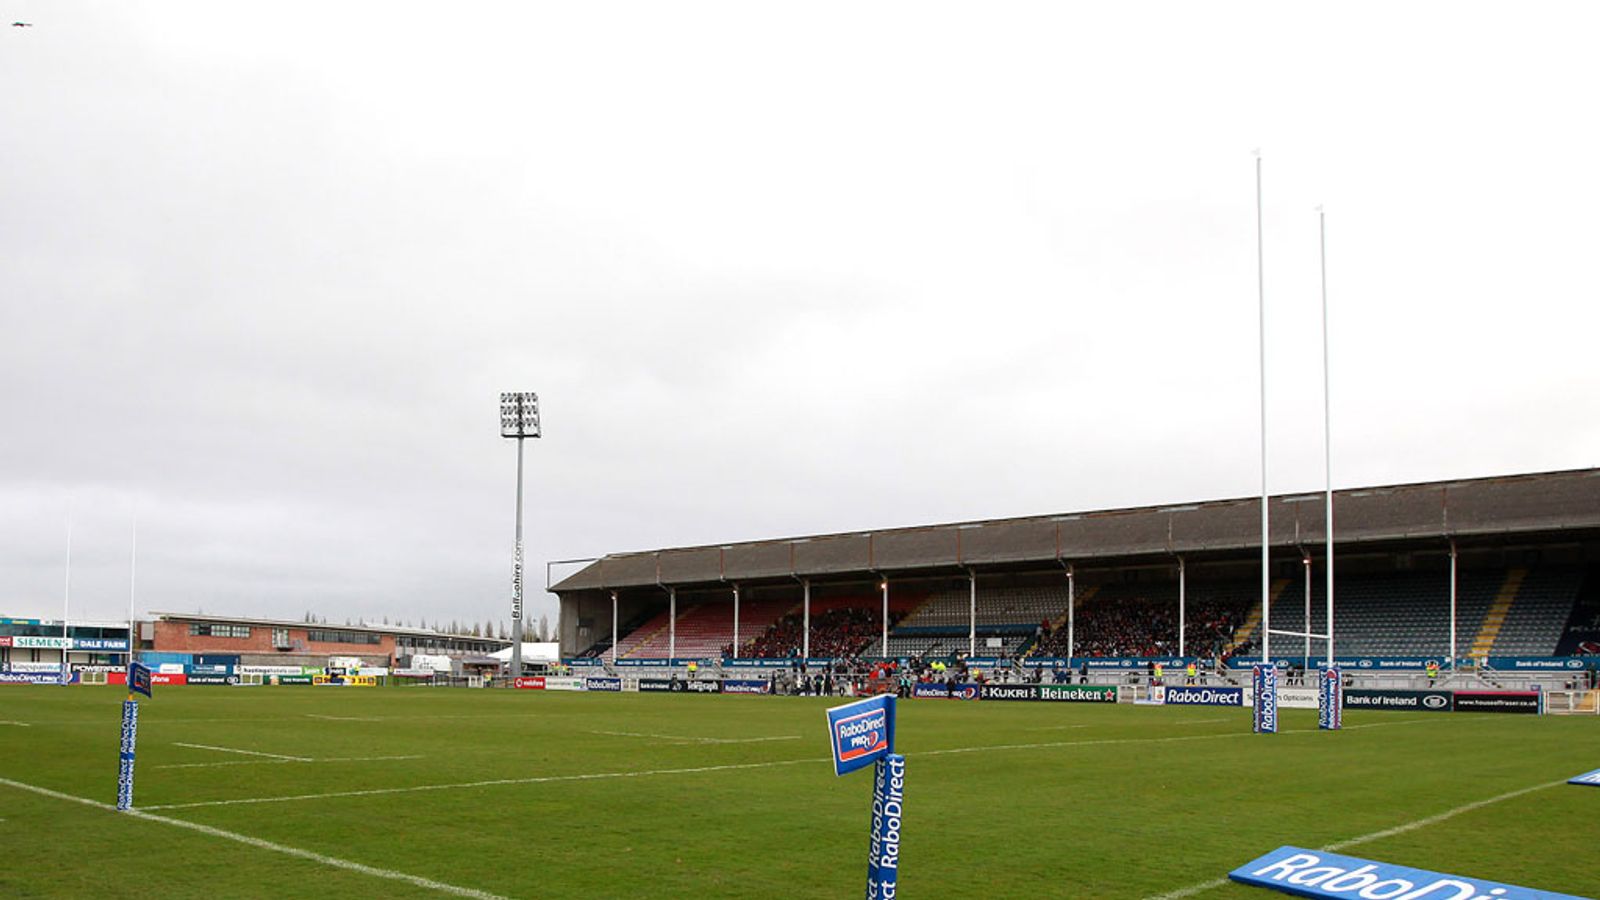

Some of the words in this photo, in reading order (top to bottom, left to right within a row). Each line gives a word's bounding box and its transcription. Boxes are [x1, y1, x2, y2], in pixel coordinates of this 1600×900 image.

[80, 640, 101, 648] DALE
[103, 641, 127, 649] FARM
[989, 687, 1028, 698] KUKRI
[1040, 687, 1102, 700] Heineken
[1167, 688, 1240, 704] RaboDirect
[1260, 667, 1273, 731] RaboDirect
[1318, 670, 1328, 727] RaboDirect
[1346, 695, 1370, 705] Bank
[1371, 696, 1382, 705] of
[1382, 696, 1417, 706] Ireland
[840, 716, 885, 739] RaboDirect
[869, 760, 887, 869] RaboDirect
[881, 758, 905, 869] RaboDirect
